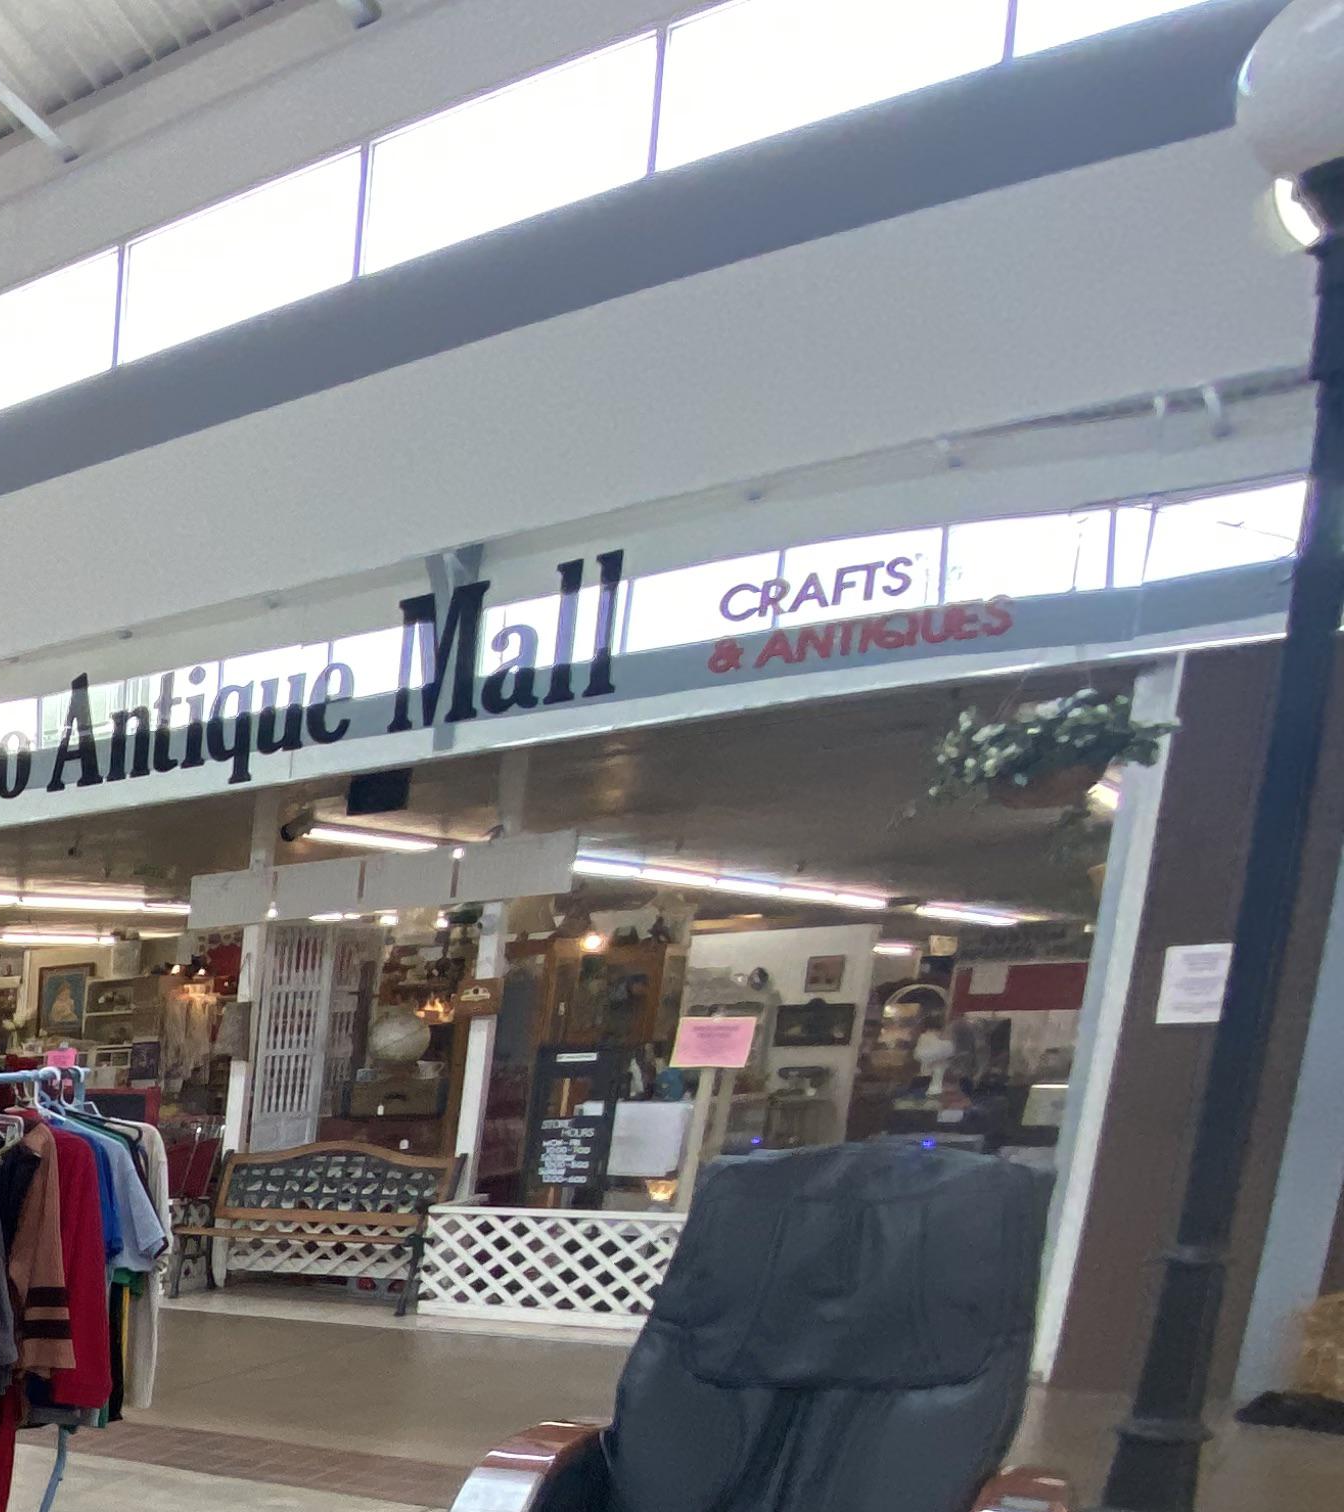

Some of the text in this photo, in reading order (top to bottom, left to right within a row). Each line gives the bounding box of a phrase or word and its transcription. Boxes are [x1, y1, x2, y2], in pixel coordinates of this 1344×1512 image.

[719, 556, 913, 622] CRAFTS
[46, 660, 355, 792] Antique
[387, 549, 624, 733] Mall
[708, 594, 1014, 674] & ANTIQUES
[561, 1127, 595, 1138] HOURS
